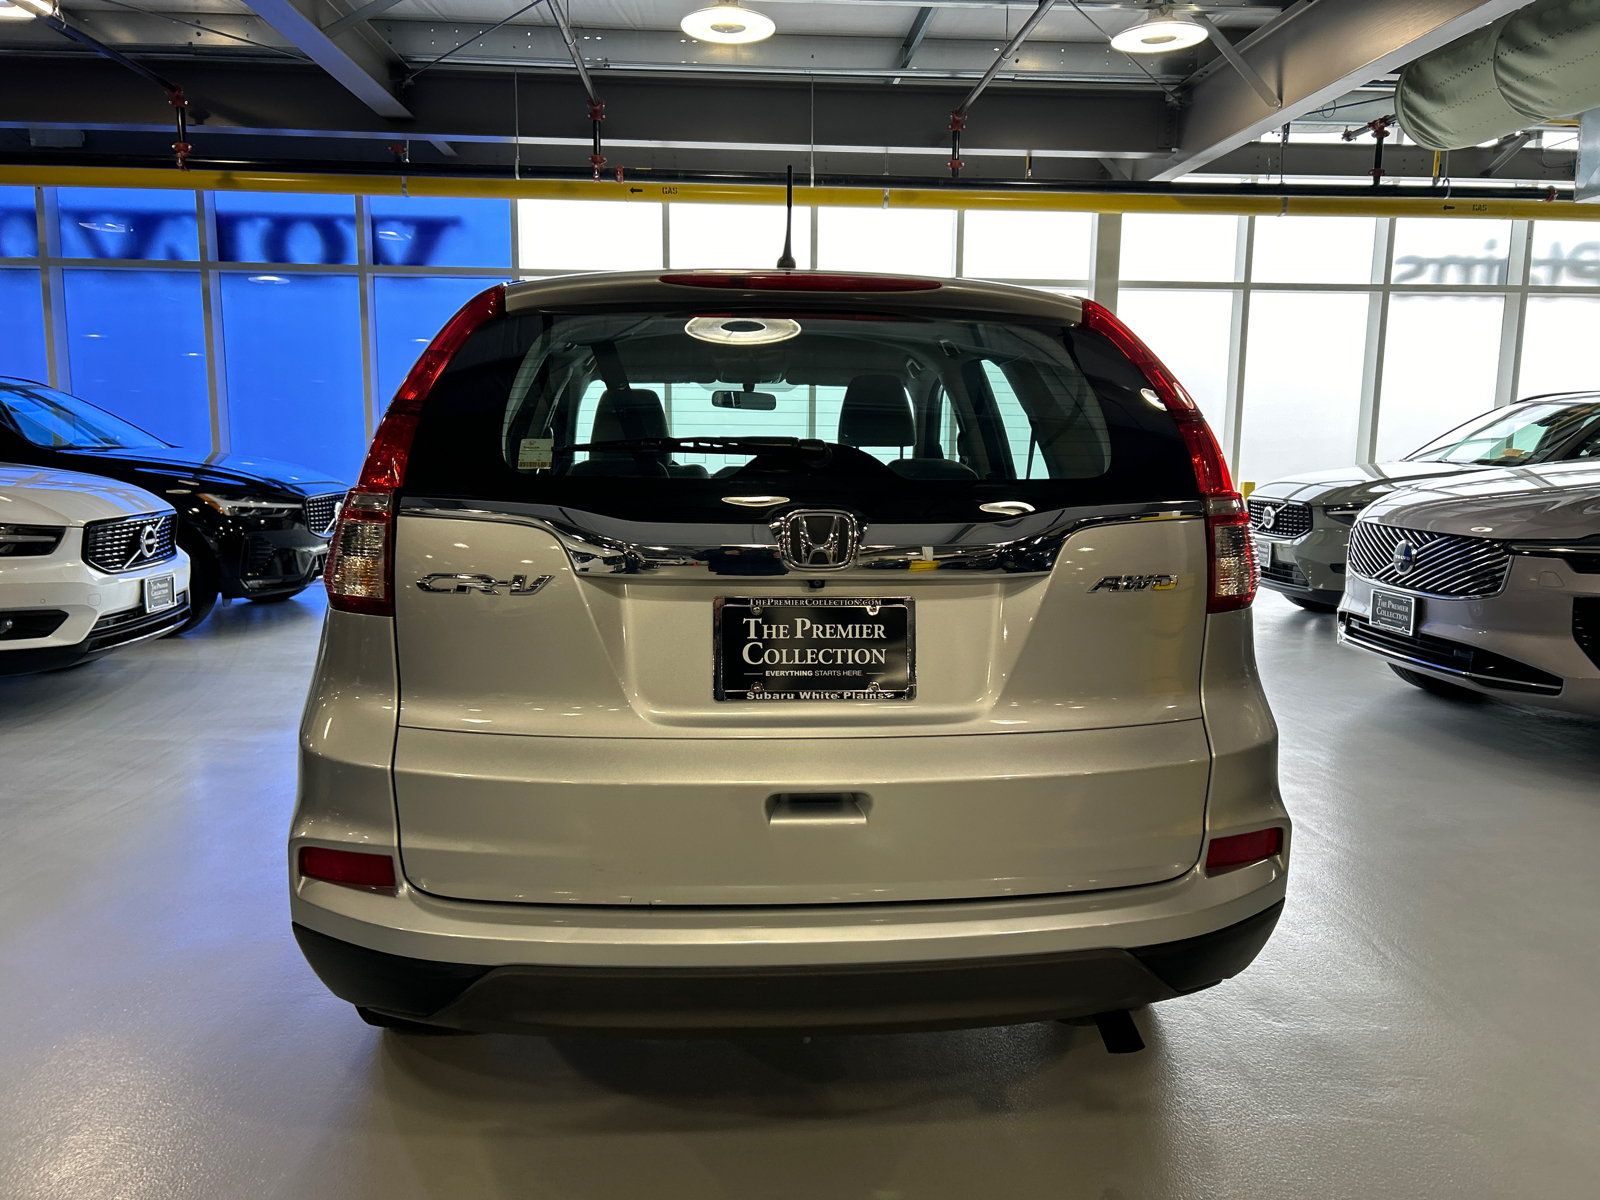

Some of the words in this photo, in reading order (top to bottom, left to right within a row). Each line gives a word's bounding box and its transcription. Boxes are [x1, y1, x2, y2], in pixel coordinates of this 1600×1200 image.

[661, 186, 678, 195] GAS
[1472, 204, 1488, 212] GAS
[416, 573, 555, 596] CR-V
[1086, 573, 1178, 593] AWD
[742, 617, 790, 639] THE
[794, 617, 887, 639] PREMIER
[742, 641, 887, 665] COLLECTION
[814, 669, 842, 677] STARTS
[746, 691, 796, 700] Subaru
[799, 691, 838, 700] White
[843, 691, 885, 700] Plains
